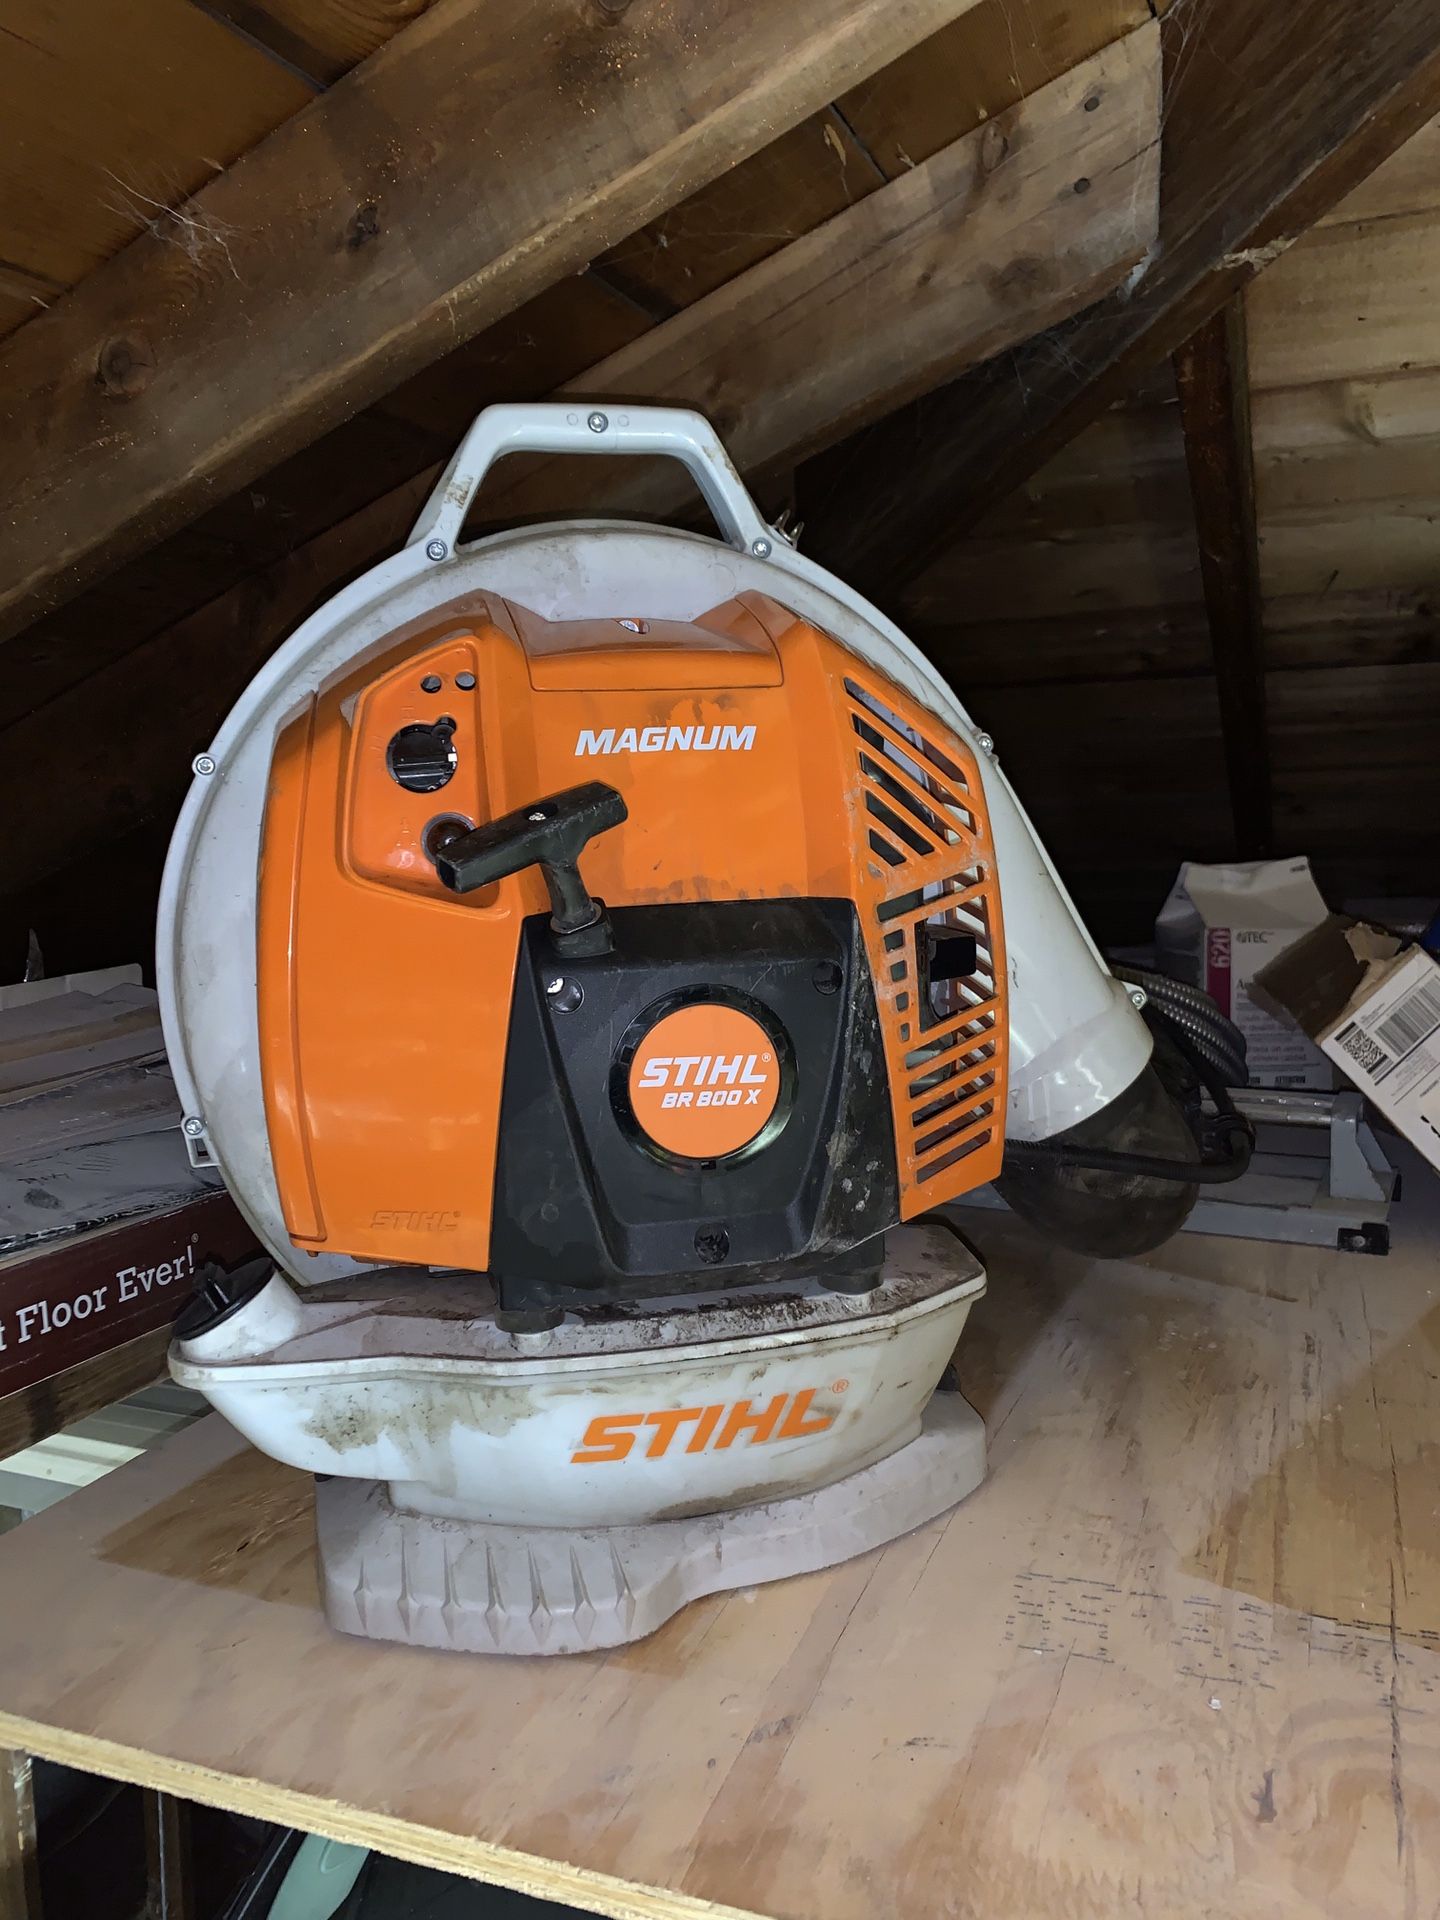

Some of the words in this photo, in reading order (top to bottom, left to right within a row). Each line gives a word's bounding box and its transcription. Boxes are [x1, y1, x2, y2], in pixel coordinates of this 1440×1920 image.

[574, 725, 757, 756] MAGNUM
[661, 1091, 694, 1109] BR
[696, 1089, 742, 1107] 800
[744, 1088, 762, 1105] X
[16, 1286, 107, 1344] Floor
[116, 1245, 196, 1303] Ever!
